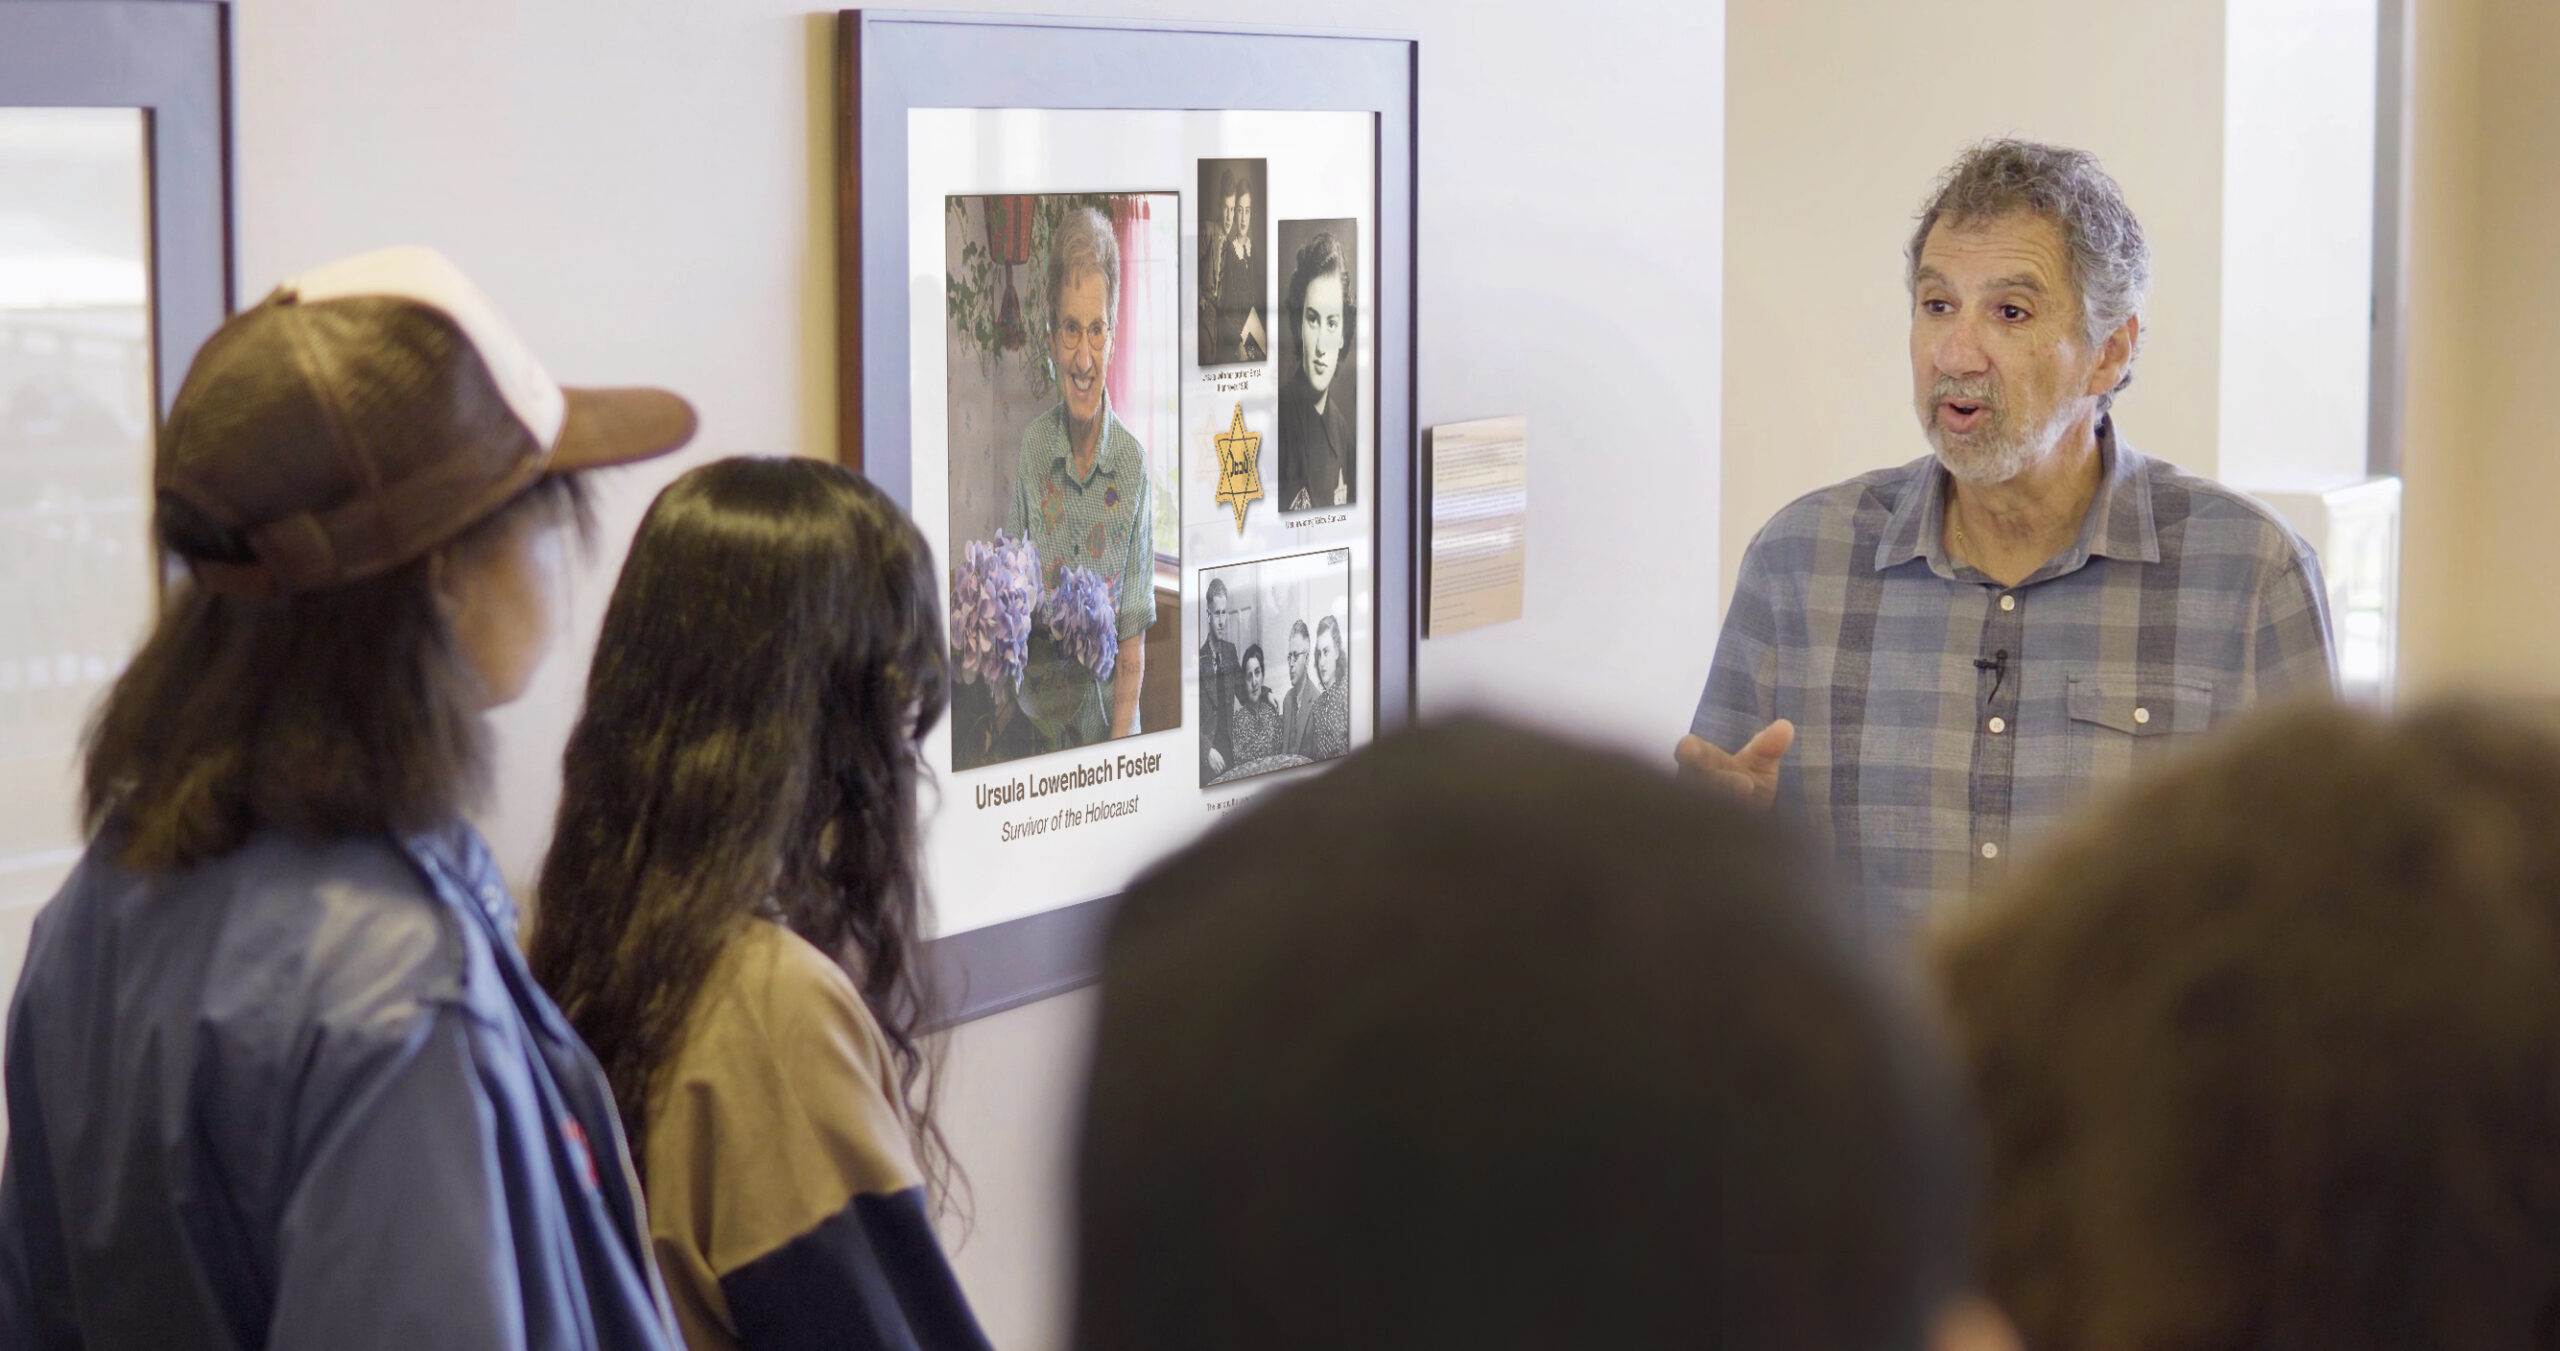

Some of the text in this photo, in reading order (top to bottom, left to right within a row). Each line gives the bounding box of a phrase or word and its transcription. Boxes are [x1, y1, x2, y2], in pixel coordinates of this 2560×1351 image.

[976, 752, 1162, 810] Ursula Lowenbach Foster
[1001, 794, 1140, 842] Survivor of the Holocaust
